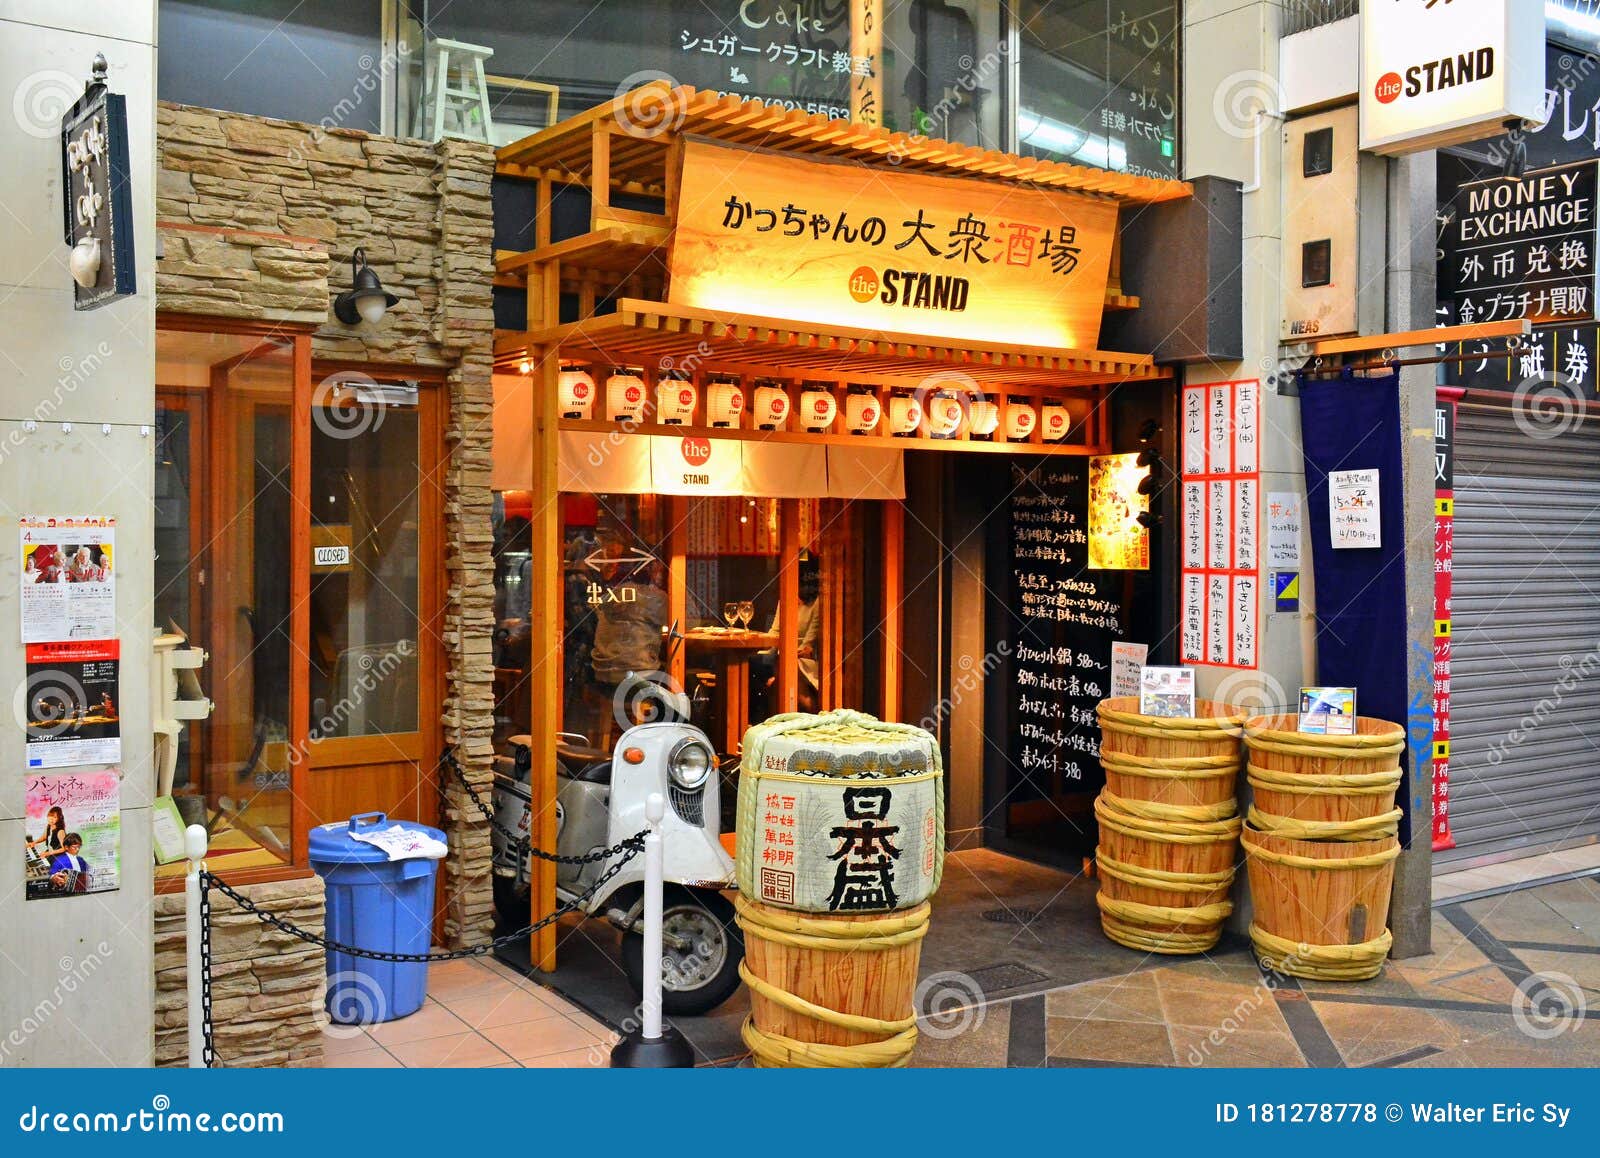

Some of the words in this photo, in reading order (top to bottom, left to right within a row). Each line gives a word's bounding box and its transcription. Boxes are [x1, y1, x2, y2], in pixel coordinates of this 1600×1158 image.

[739, 0, 825, 34] Cake
[680, 29, 872, 78] シュガークラフト教室
[1377, 80, 1400, 98] the
[1405, 46, 1494, 98] STAND
[1469, 171, 1580, 213] MONEY
[1461, 198, 1588, 241] EXCHANGE
[723, 196, 886, 246] かっちゃんの
[895, 209, 1082, 276] 大衆酒場
[852, 273, 877, 295] the
[881, 267, 969, 313] STAND
[1291, 320, 1319, 335] NEAS
[575, 386, 588, 395] the
[626, 391, 640, 399] the
[815, 402, 829, 411] the
[1188, 392, 1199, 433] ハイボール
[684, 441, 709, 458] the
[683, 474, 709, 485] STAND
[1356, 489, 1367, 497] 22
[318, 549, 346, 562] CLOSED
[586, 582, 637, 604] 出入口
[1237, 580, 1252, 622] やきとり
[1016, 640, 1072, 666] おひとり小鍋
[1019, 694, 1065, 719] おばんざい
